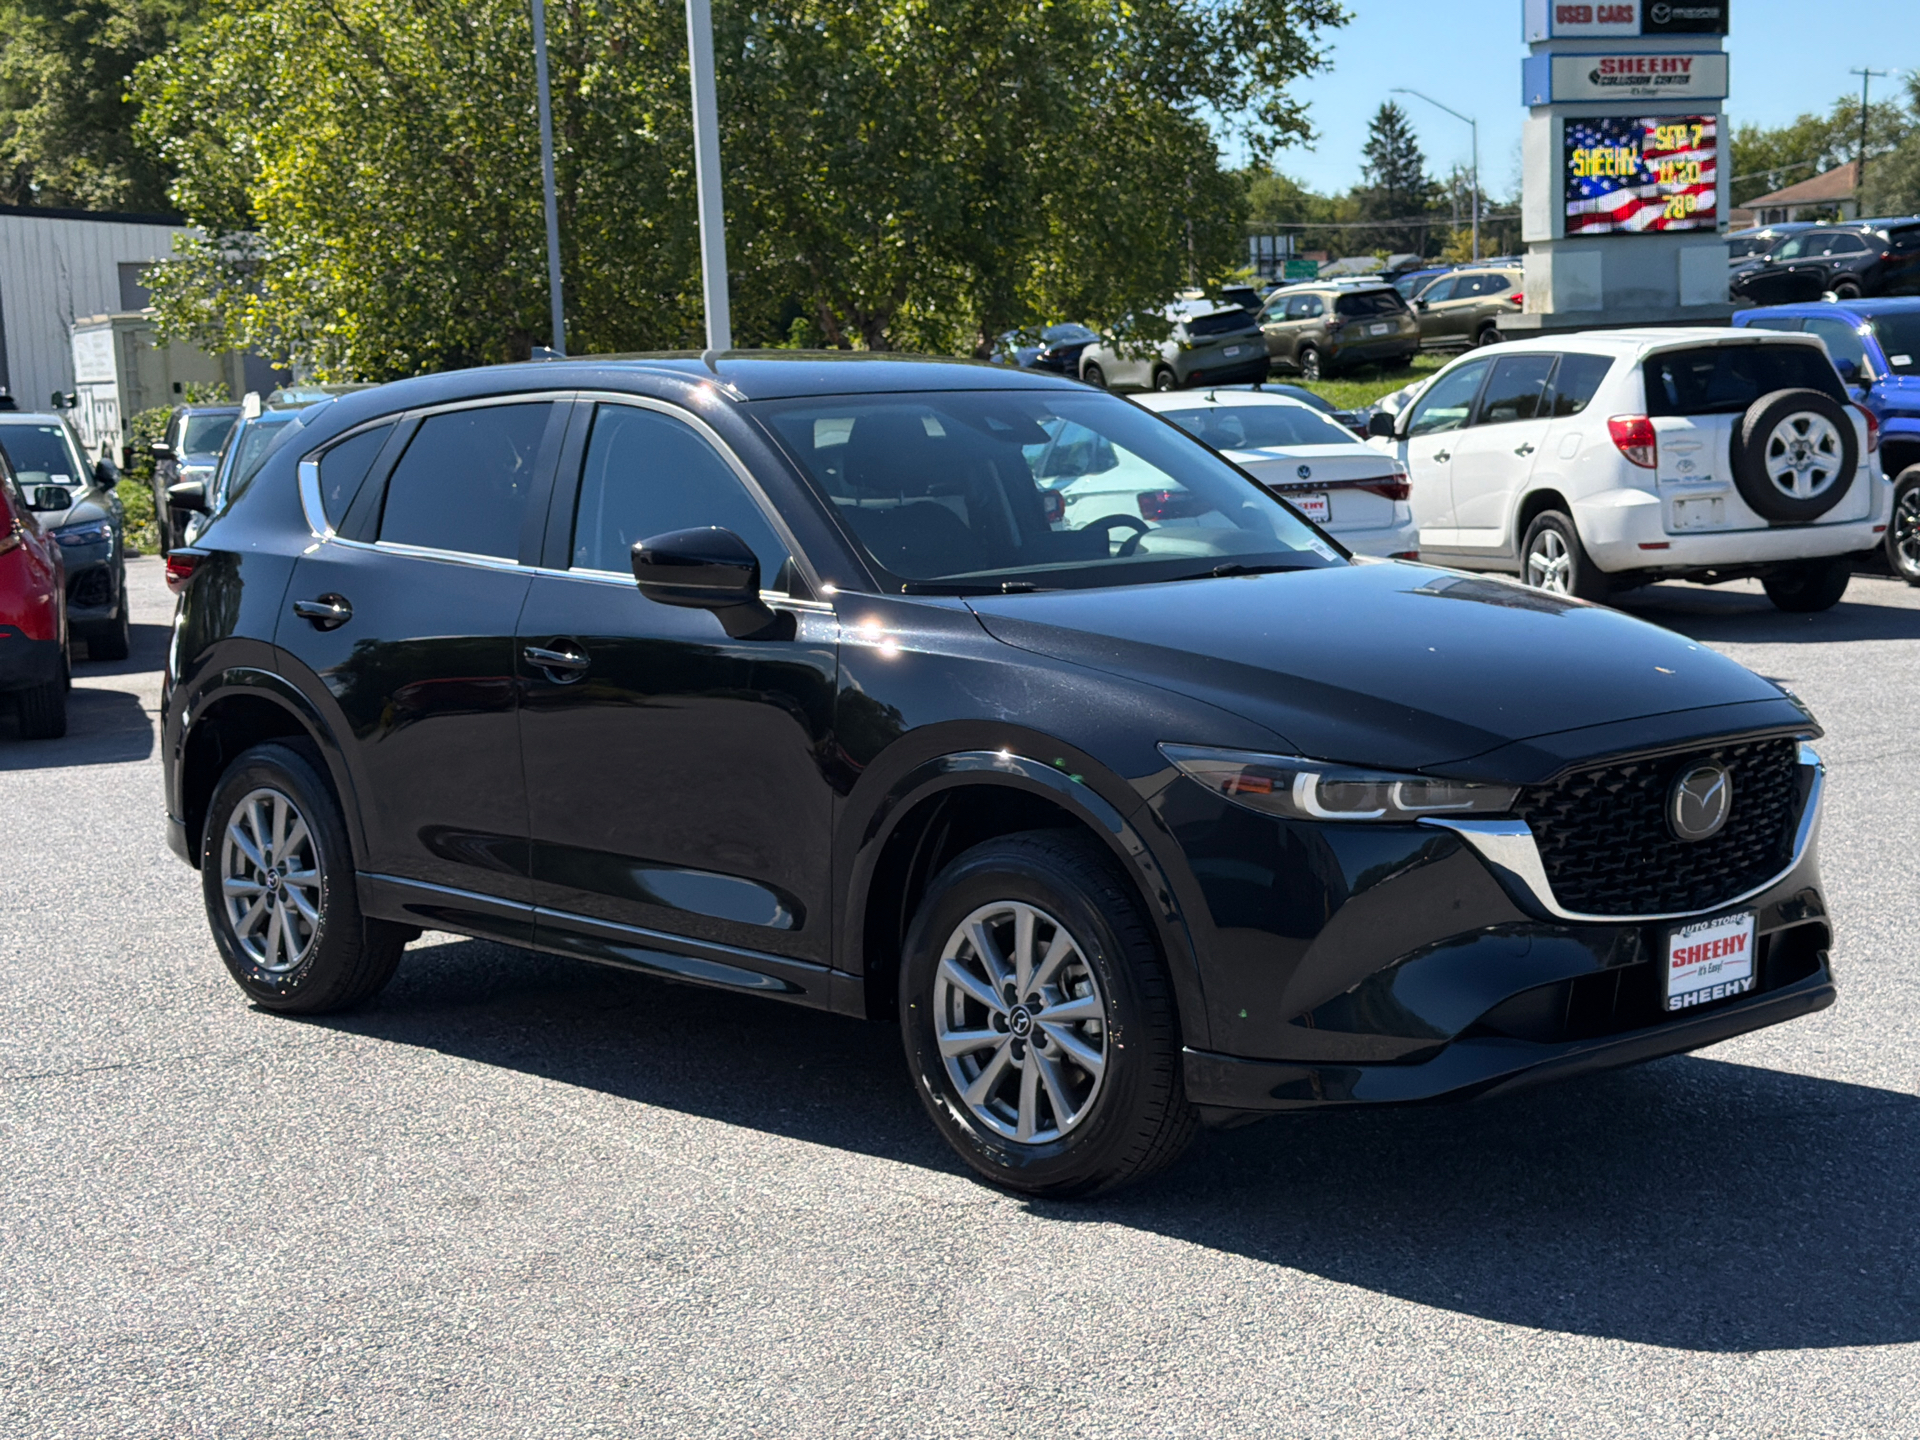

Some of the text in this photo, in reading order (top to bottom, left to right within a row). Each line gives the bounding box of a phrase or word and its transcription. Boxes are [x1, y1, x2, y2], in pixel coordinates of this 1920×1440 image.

[1555, 5, 1634, 23] USED CARS
[1599, 57, 1693, 74] SHEEHY
[1600, 74, 1692, 86] COLLISION CENTER
[1655, 124, 1704, 150] SEP 7
[1572, 147, 1638, 177] SHEEHY
[1680, 912, 1749, 936] AUTO STORES
[1672, 932, 1748, 968] SHEEHY
[1708, 960, 1724, 974] Easy!
[1669, 977, 1753, 1011] SHEEHY
